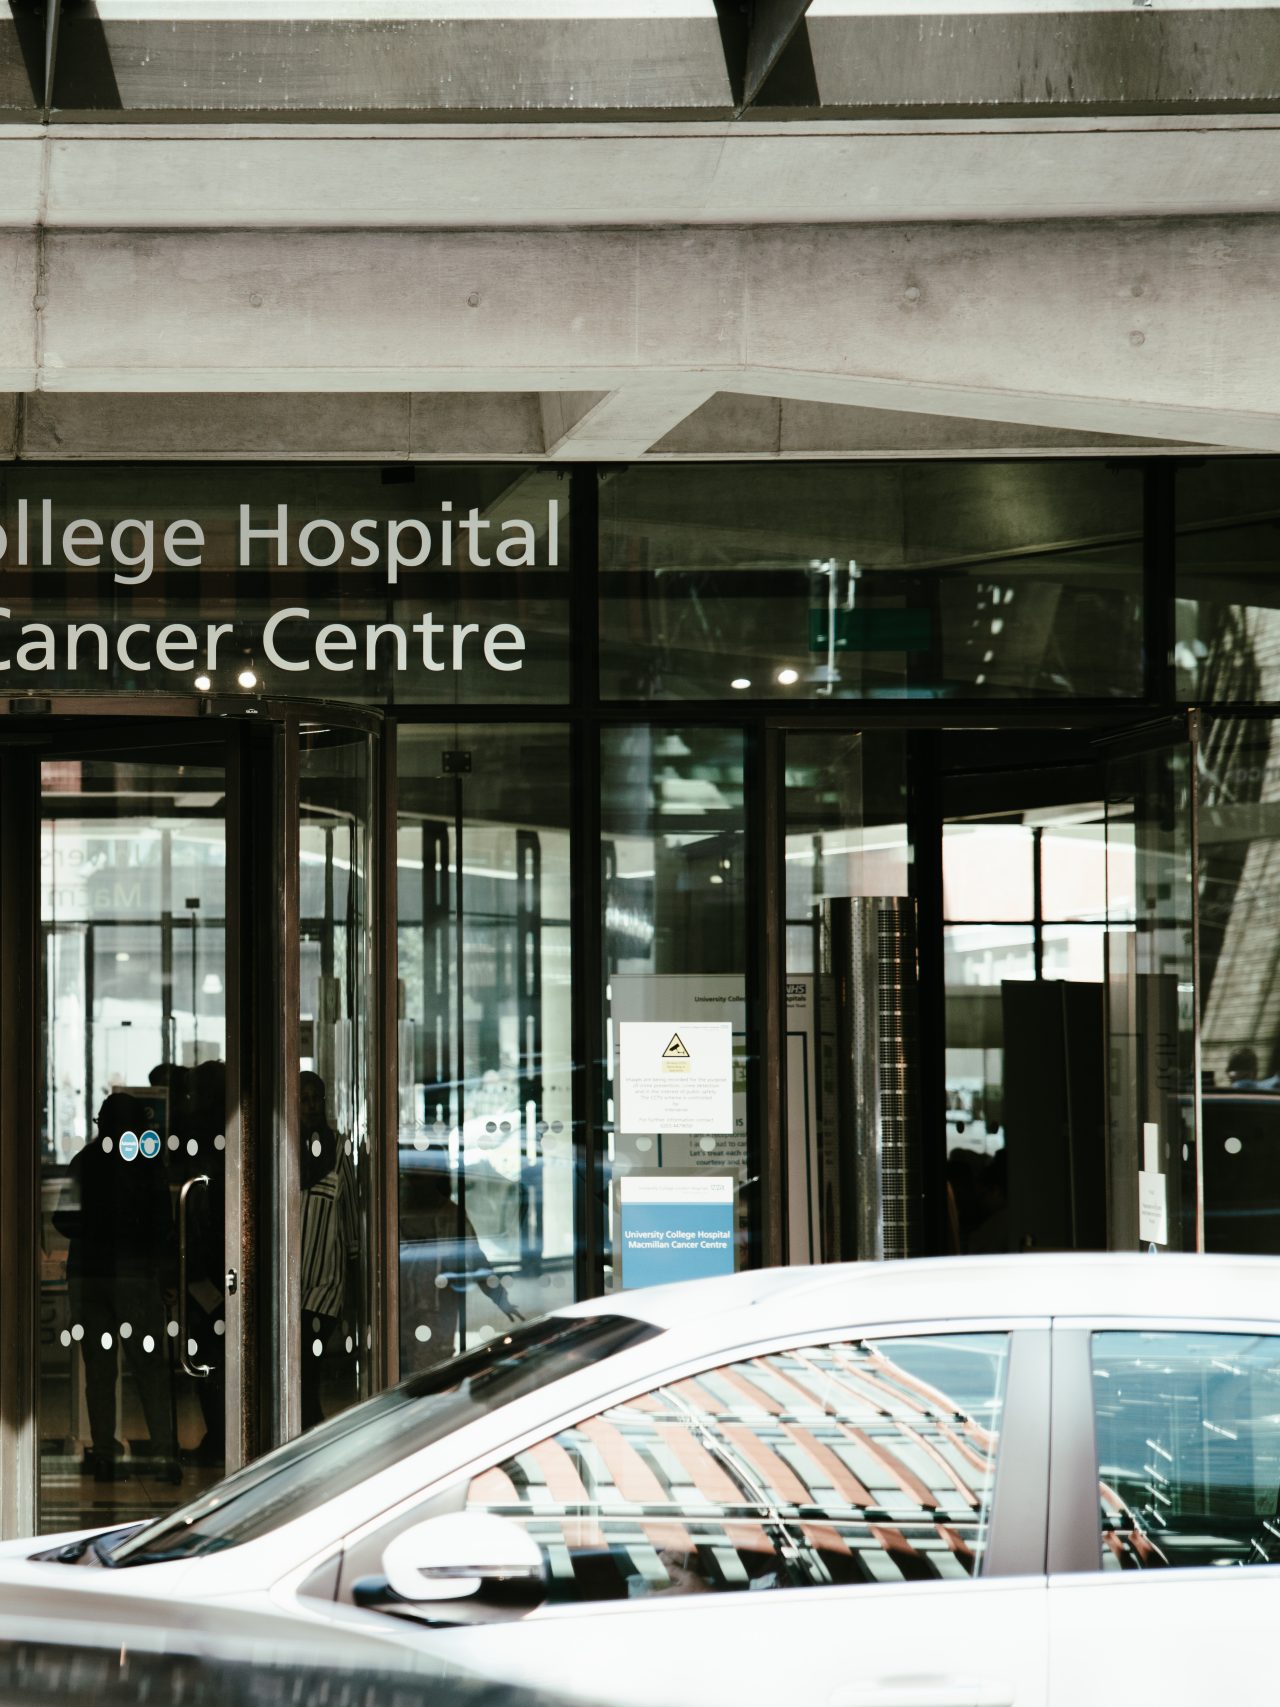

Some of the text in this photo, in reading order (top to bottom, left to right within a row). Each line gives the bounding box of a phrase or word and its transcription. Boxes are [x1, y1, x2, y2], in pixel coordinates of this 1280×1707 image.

[239, 499, 559, 584] Hospital
[262, 607, 526, 672] Centre
[694, 995, 726, 1004] University
[624, 1231, 730, 1240] University College Hospital
[628, 1241, 728, 1249] Macmillan Cancer Centre
